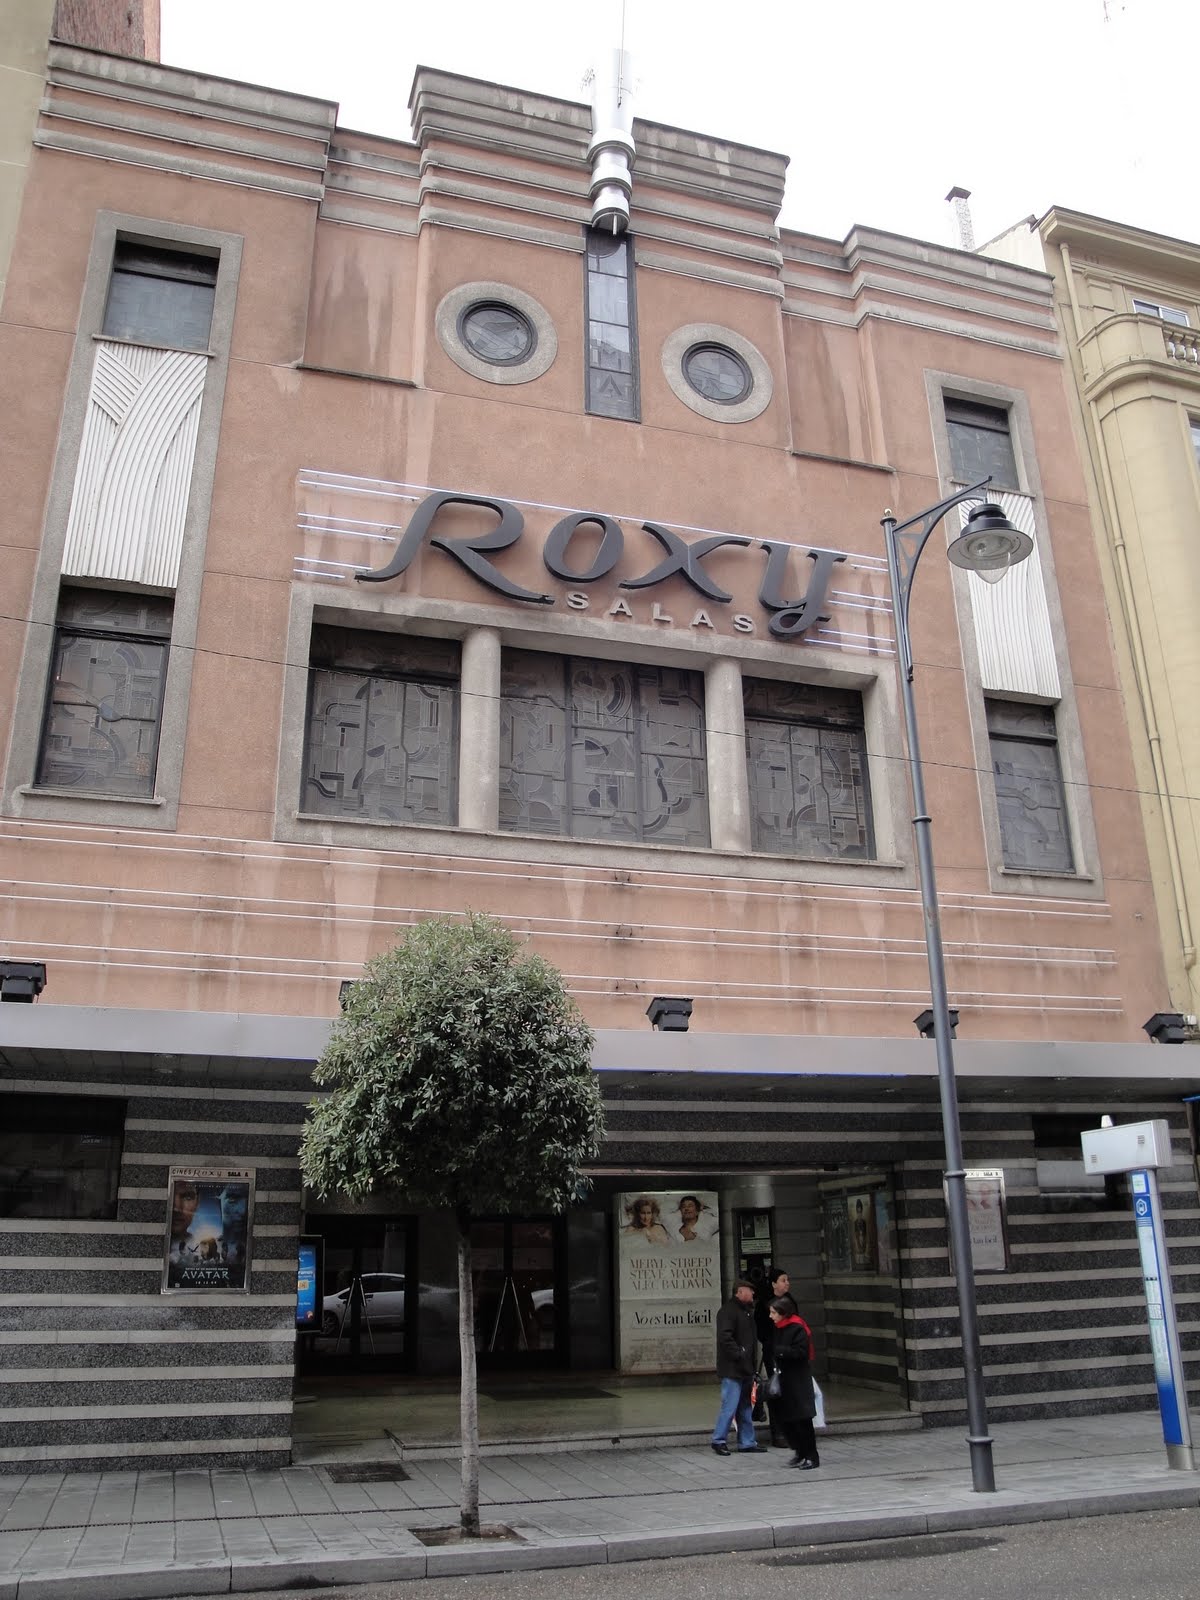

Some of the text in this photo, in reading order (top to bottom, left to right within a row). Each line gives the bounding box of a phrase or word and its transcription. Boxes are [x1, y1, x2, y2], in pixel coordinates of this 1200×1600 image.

[566, 592, 755, 633] SALAS
[630, 1257, 712, 1269] MERYL STREEP
[181, 1270, 230, 1280] AVATAR
[629, 1268, 712, 1280] STEVE MARTIN
[631, 1278, 712, 1290] ALEC BALDWIN
[634, 1309, 711, 1325] No es tan fácil
